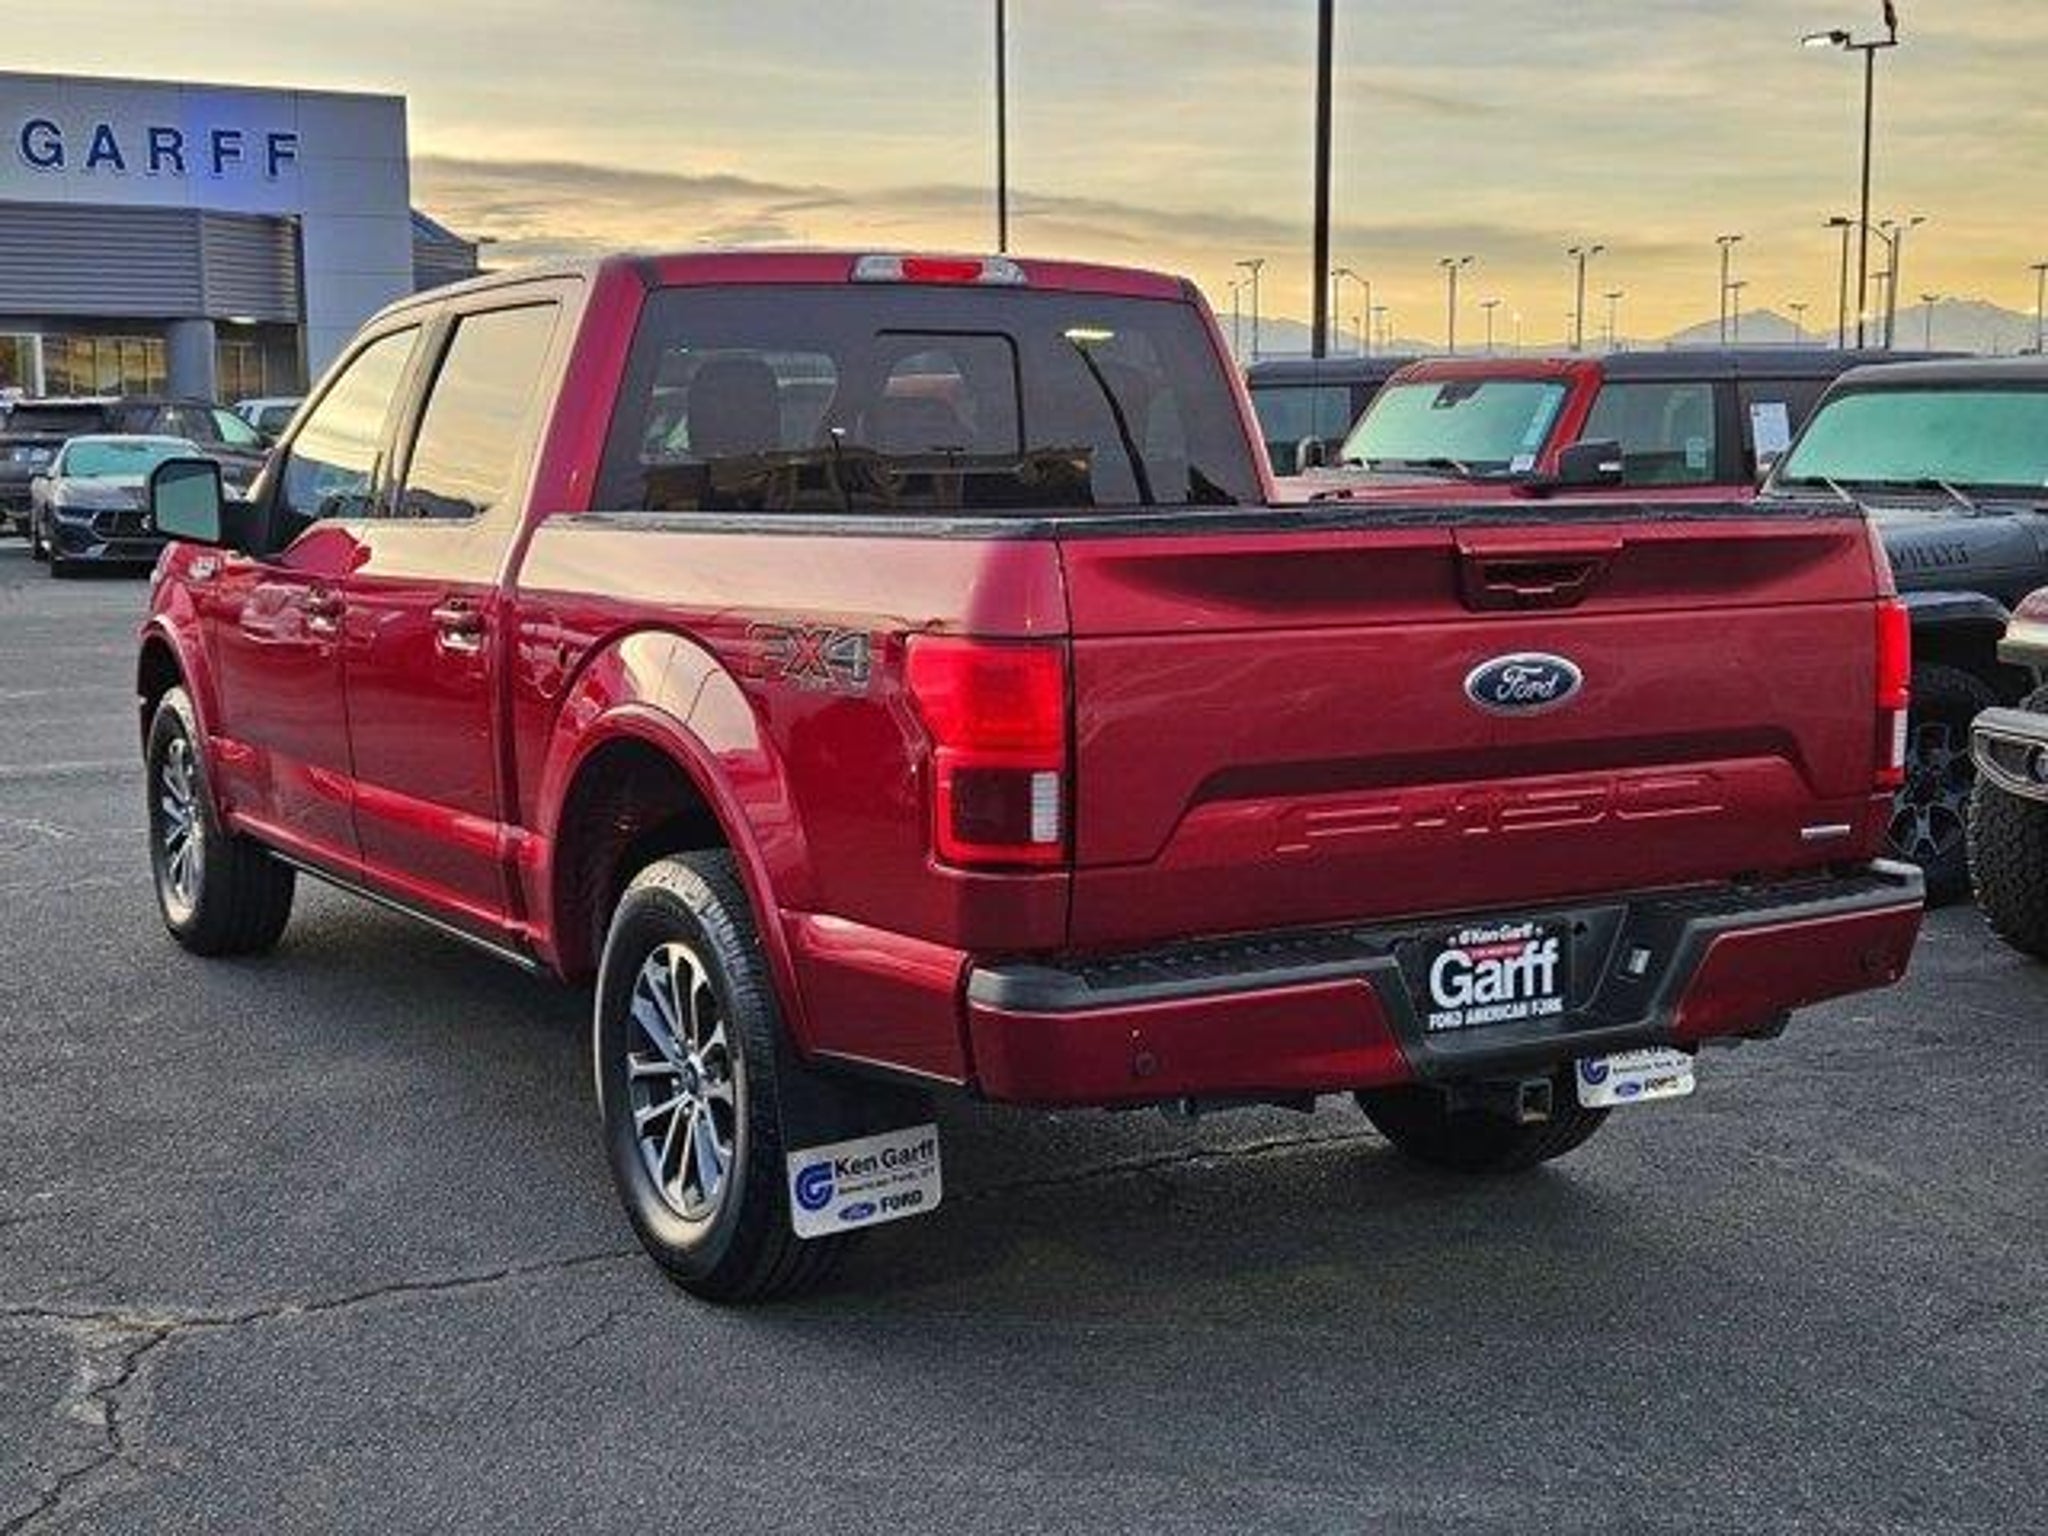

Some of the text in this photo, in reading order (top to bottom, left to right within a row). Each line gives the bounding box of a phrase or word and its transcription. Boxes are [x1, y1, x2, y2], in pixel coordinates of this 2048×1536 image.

[20, 118, 299, 177] GARFF
[746, 624, 870, 682] FX4
[1496, 665, 1559, 701] Ford
[1273, 770, 1726, 854] F-150
[1430, 937, 1559, 1009] Garff
[1429, 1010, 1463, 1031] FORD
[1465, 1002, 1528, 1026] AMERICAN
[835, 1138, 936, 1178] Ken Garff
[879, 1190, 924, 1213] FORD
